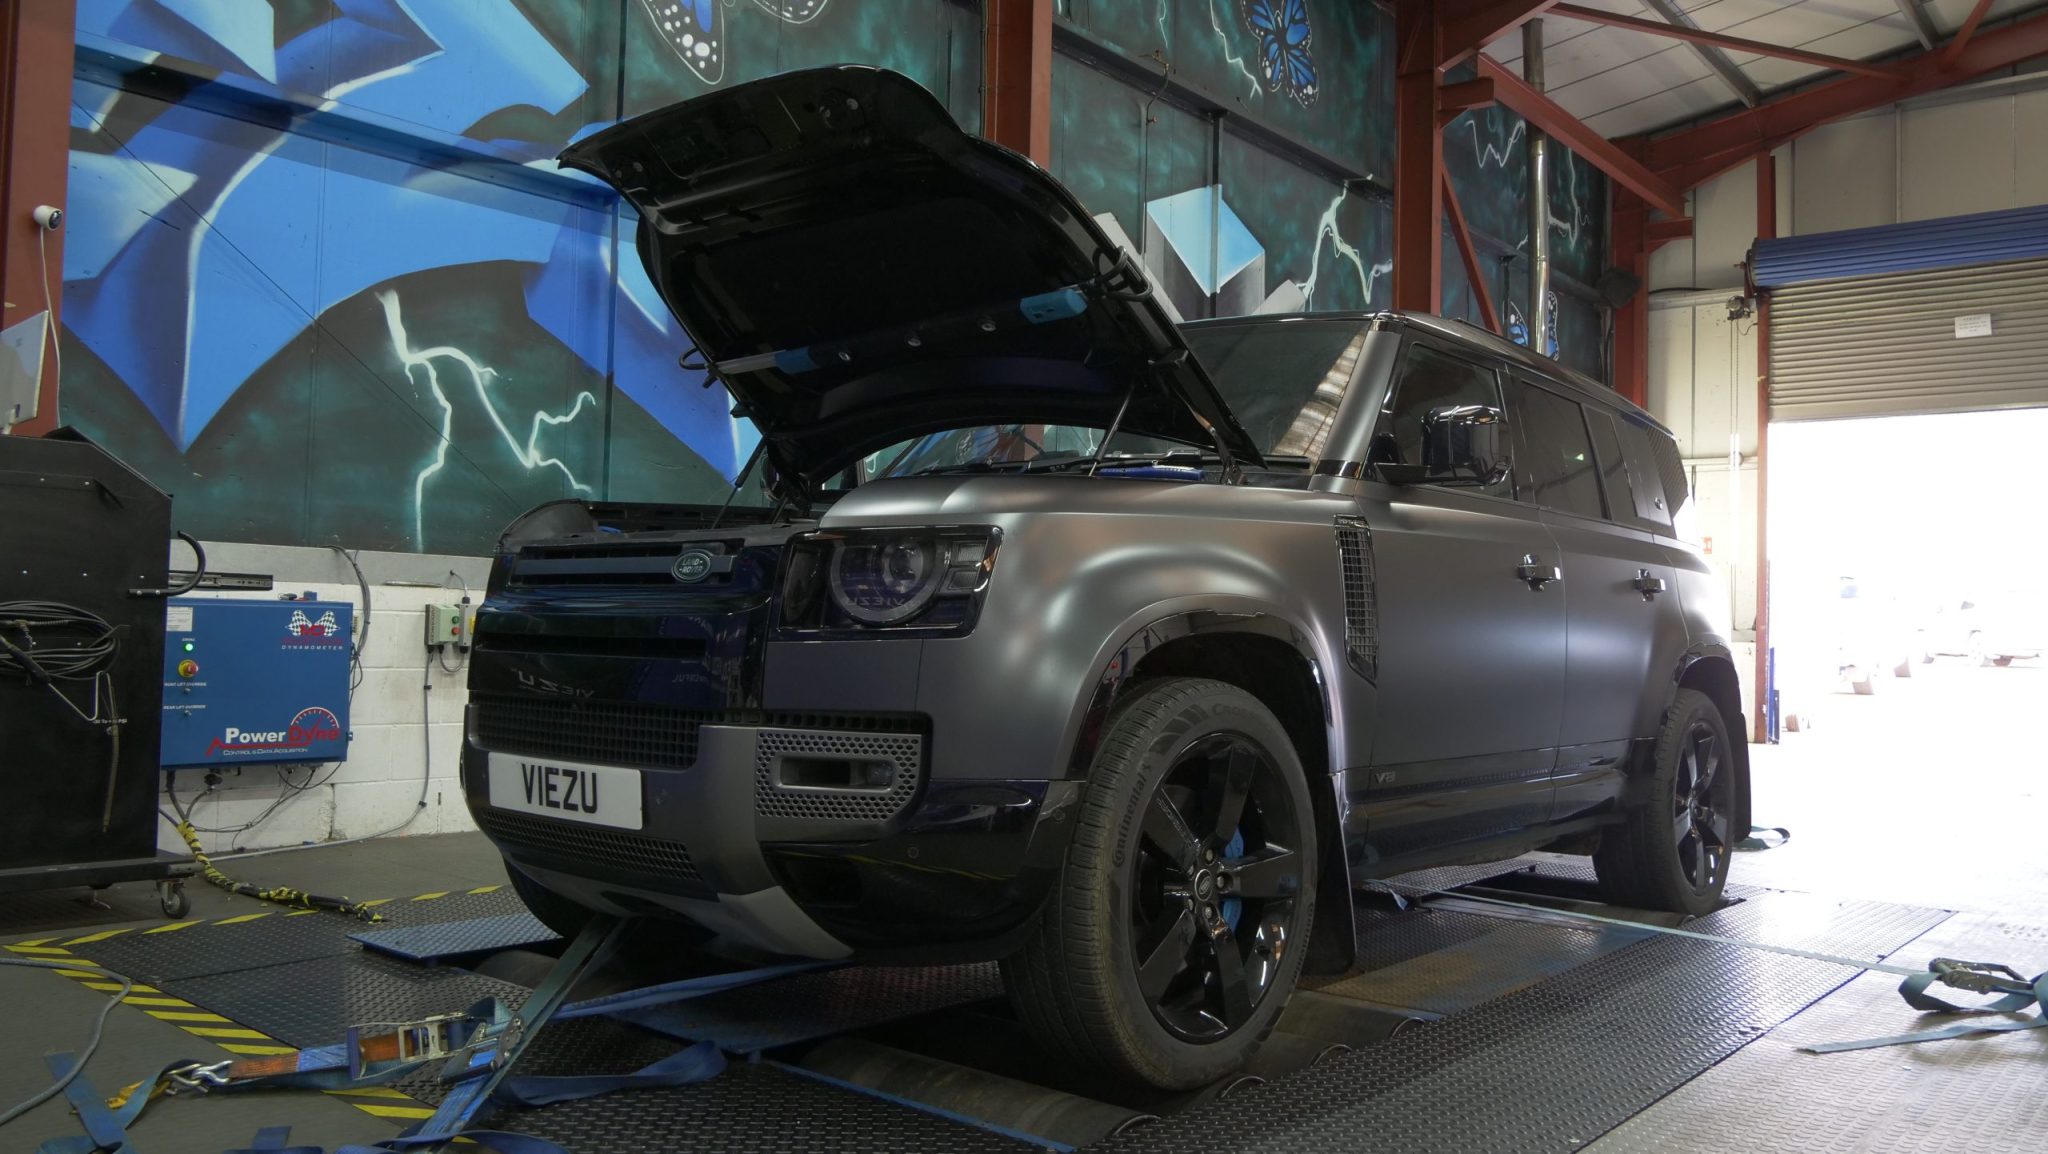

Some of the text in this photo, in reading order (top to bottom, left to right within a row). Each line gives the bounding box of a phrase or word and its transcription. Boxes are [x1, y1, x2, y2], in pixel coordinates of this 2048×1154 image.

[225, 728, 287, 744] Power
[521, 763, 598, 814] VIEZU
[1374, 771, 1396, 784] V8
[1112, 771, 1147, 868] Continental
